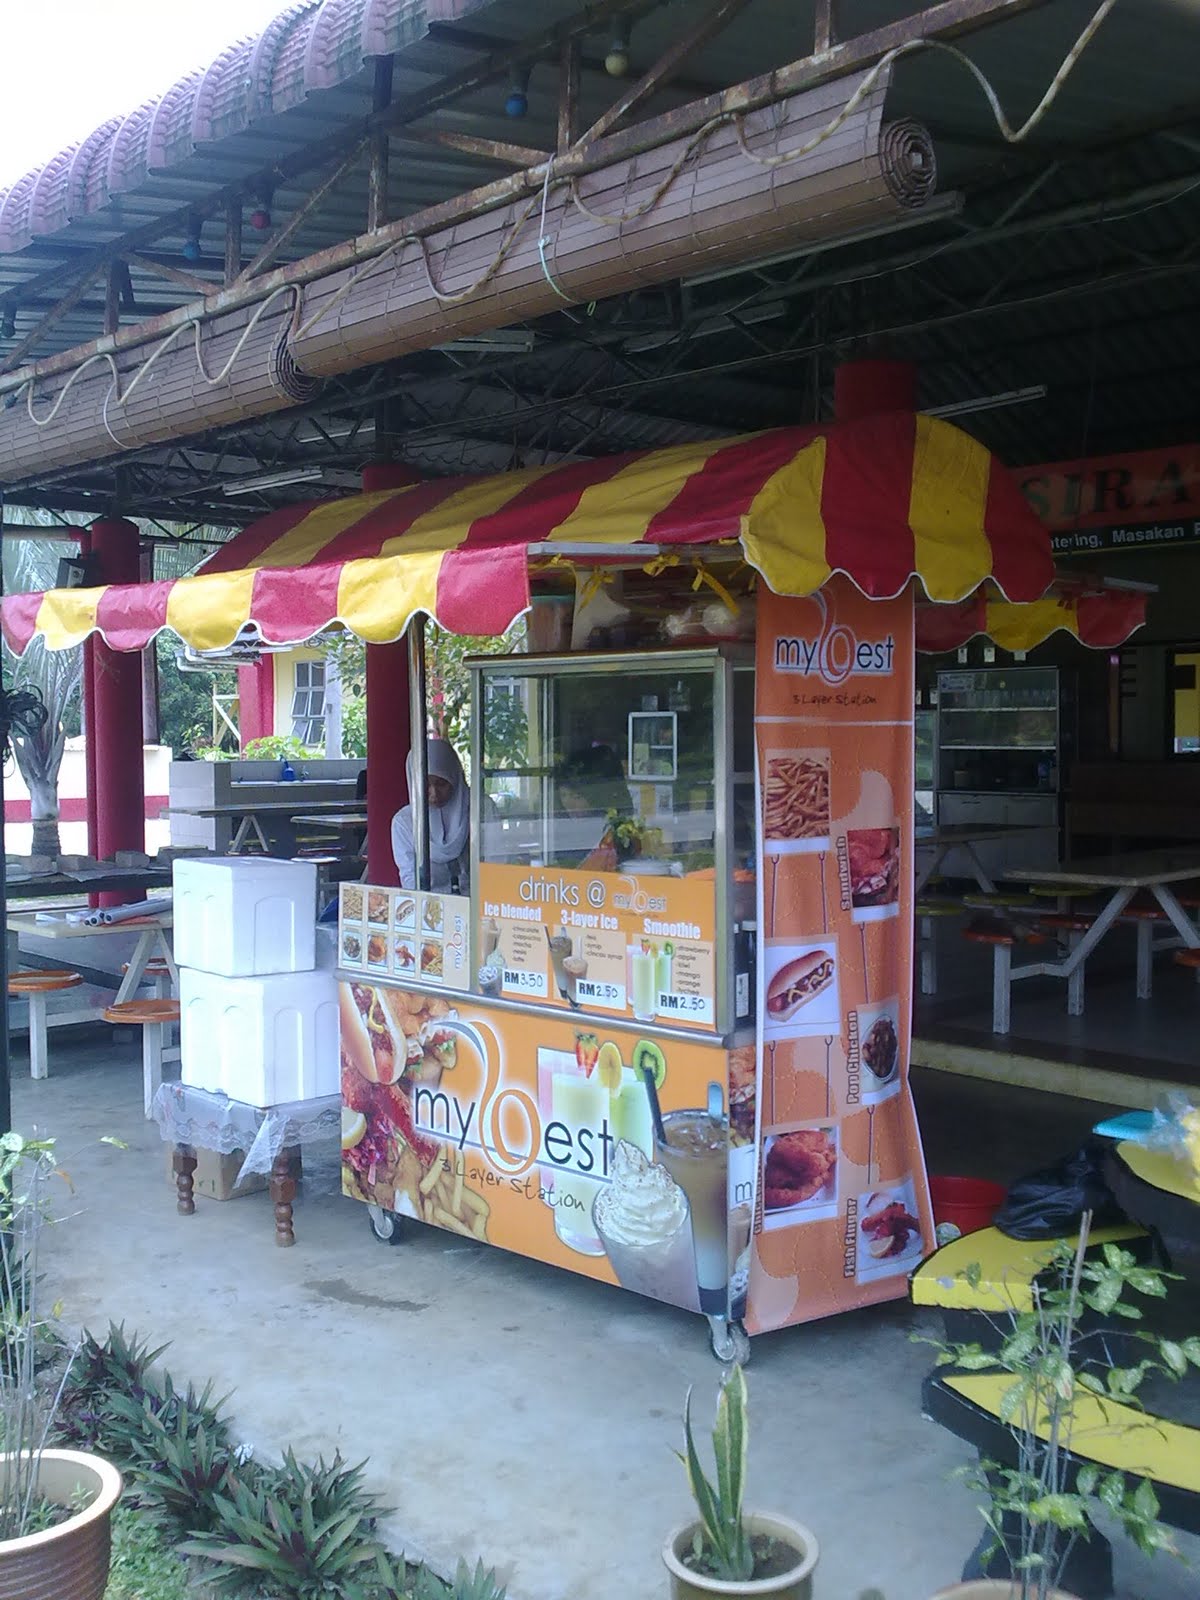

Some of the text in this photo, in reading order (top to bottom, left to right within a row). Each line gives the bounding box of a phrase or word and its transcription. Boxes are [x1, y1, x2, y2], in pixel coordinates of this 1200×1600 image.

[1050, 533, 1103, 549] tering,
[1112, 525, 1185, 544] Masakan
[835, 692, 877, 706] Station
[519, 874, 580, 906] drinks
[586, 879, 607, 909] @
[483, 900, 542, 922] Ice blended
[560, 908, 599, 929] 3-layer
[643, 917, 701, 940] Smoothie
[846, 1010, 859, 1105] Pop Chicken
[455, 1165, 504, 1189] Layer
[509, 1176, 586, 1212] Station
[844, 1198, 858, 1278] Fish Finger
